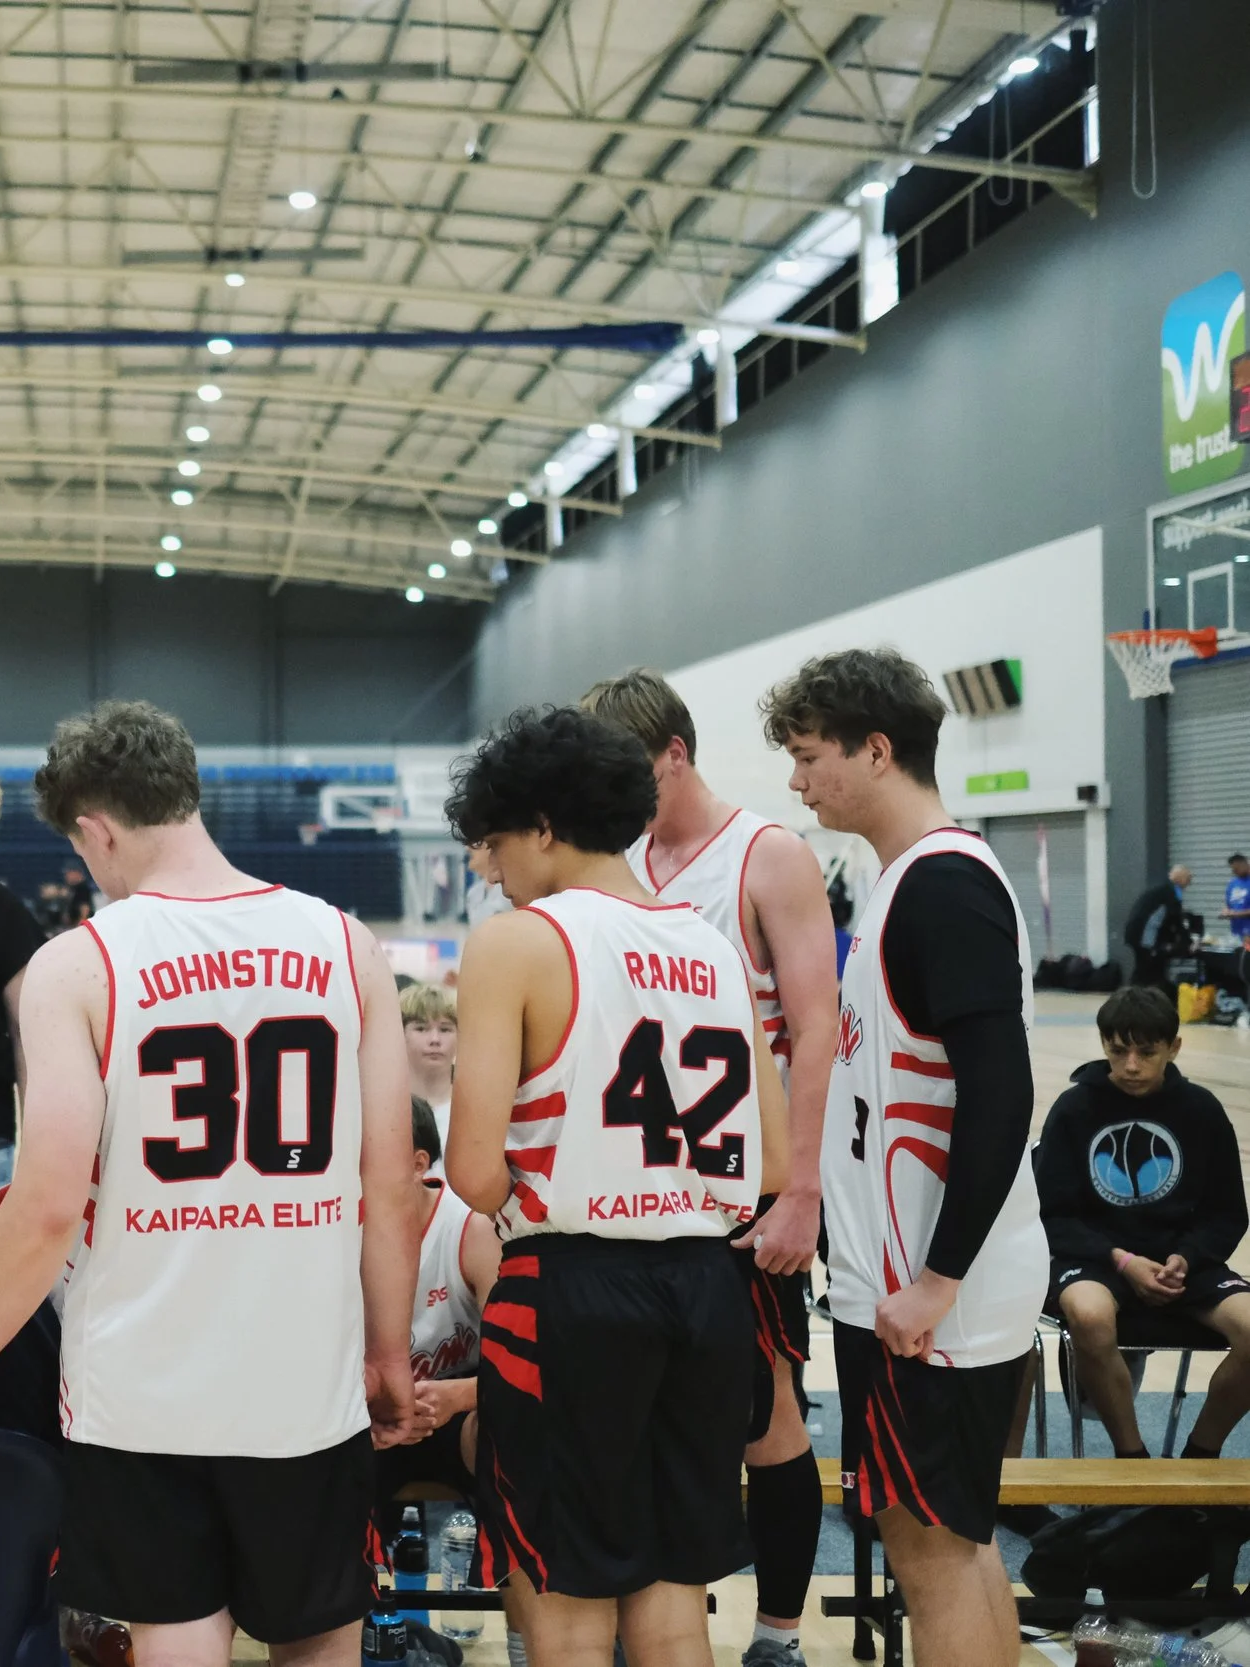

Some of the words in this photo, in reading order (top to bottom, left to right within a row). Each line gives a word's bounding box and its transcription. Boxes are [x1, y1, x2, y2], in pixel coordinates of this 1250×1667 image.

[1170, 443, 1193, 473] the
[138, 948, 333, 1010] JOHNSTON
[624, 951, 716, 1000] RANGI
[137, 1015, 339, 1183] 30
[602, 1016, 751, 1180] 42
[126, 1204, 265, 1233] KAIPARA
[273, 1196, 342, 1229] ELITE
[588, 1190, 694, 1221] KAIPARA
